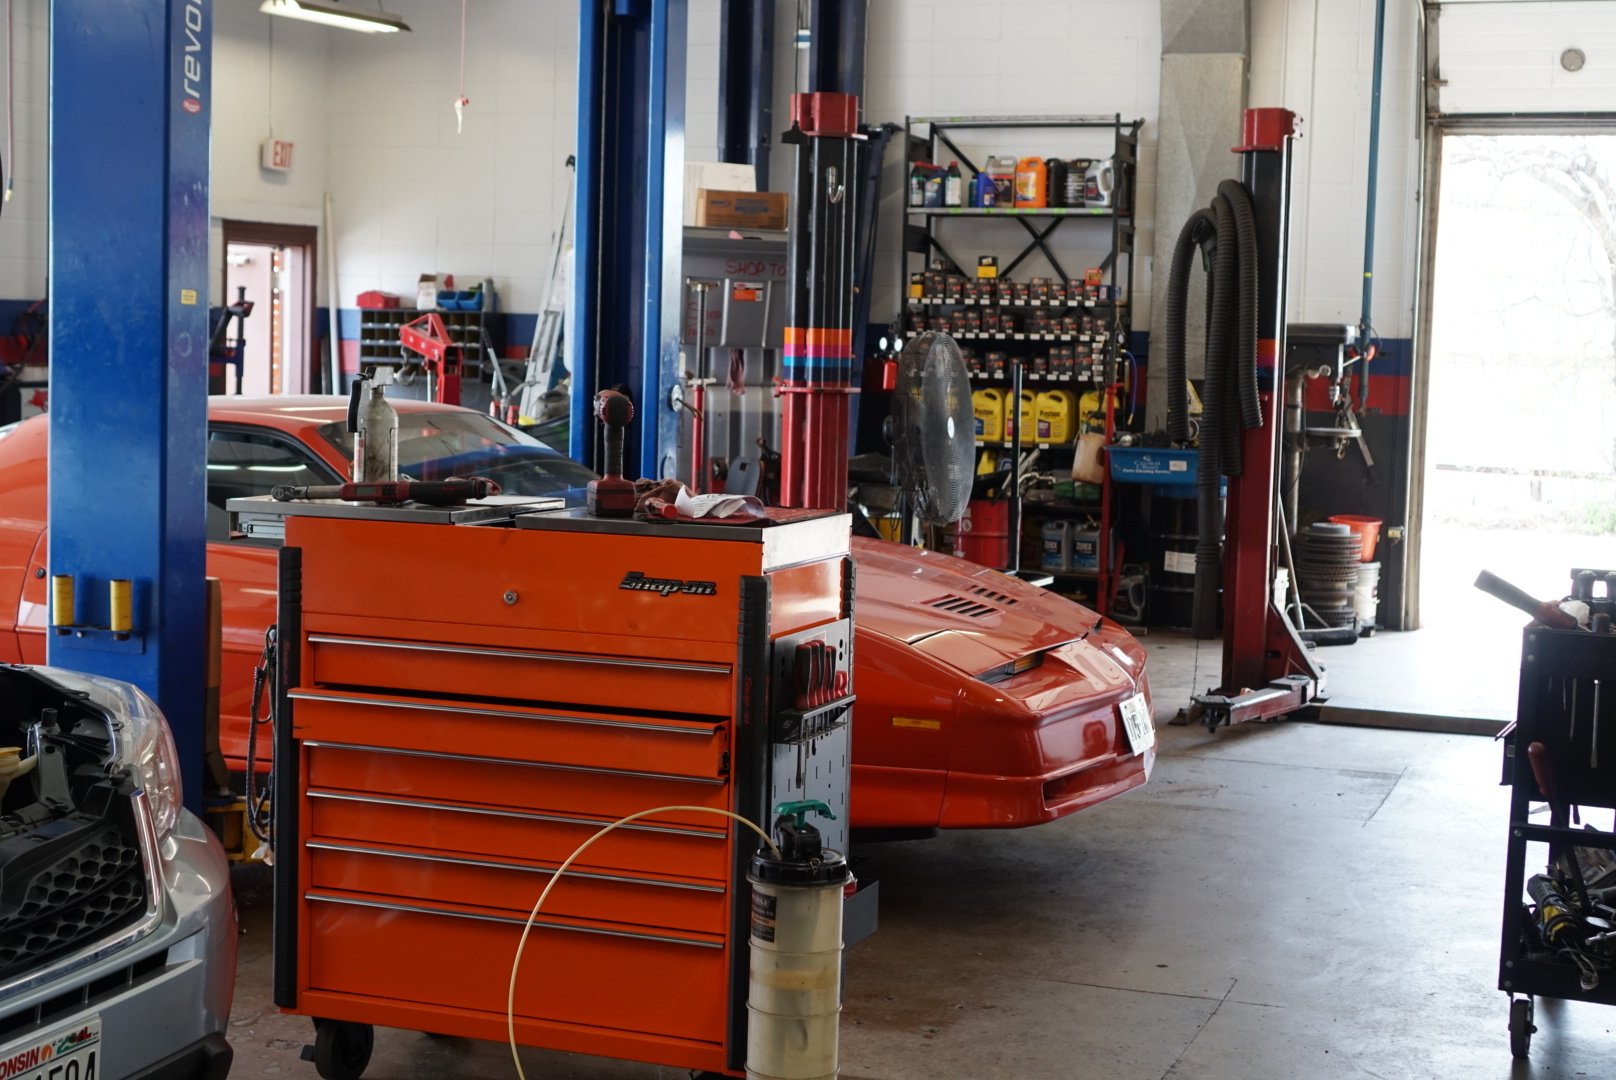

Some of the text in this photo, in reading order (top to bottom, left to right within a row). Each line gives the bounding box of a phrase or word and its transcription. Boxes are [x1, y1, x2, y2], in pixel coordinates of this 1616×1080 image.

[184, 0, 202, 98] revo
[272, 140, 293, 168] EXIT
[725, 260, 787, 276] SHOP TO
[620, 571, 716, 596] Snap-on
[0, 1046, 40, 1080] ONSIN
